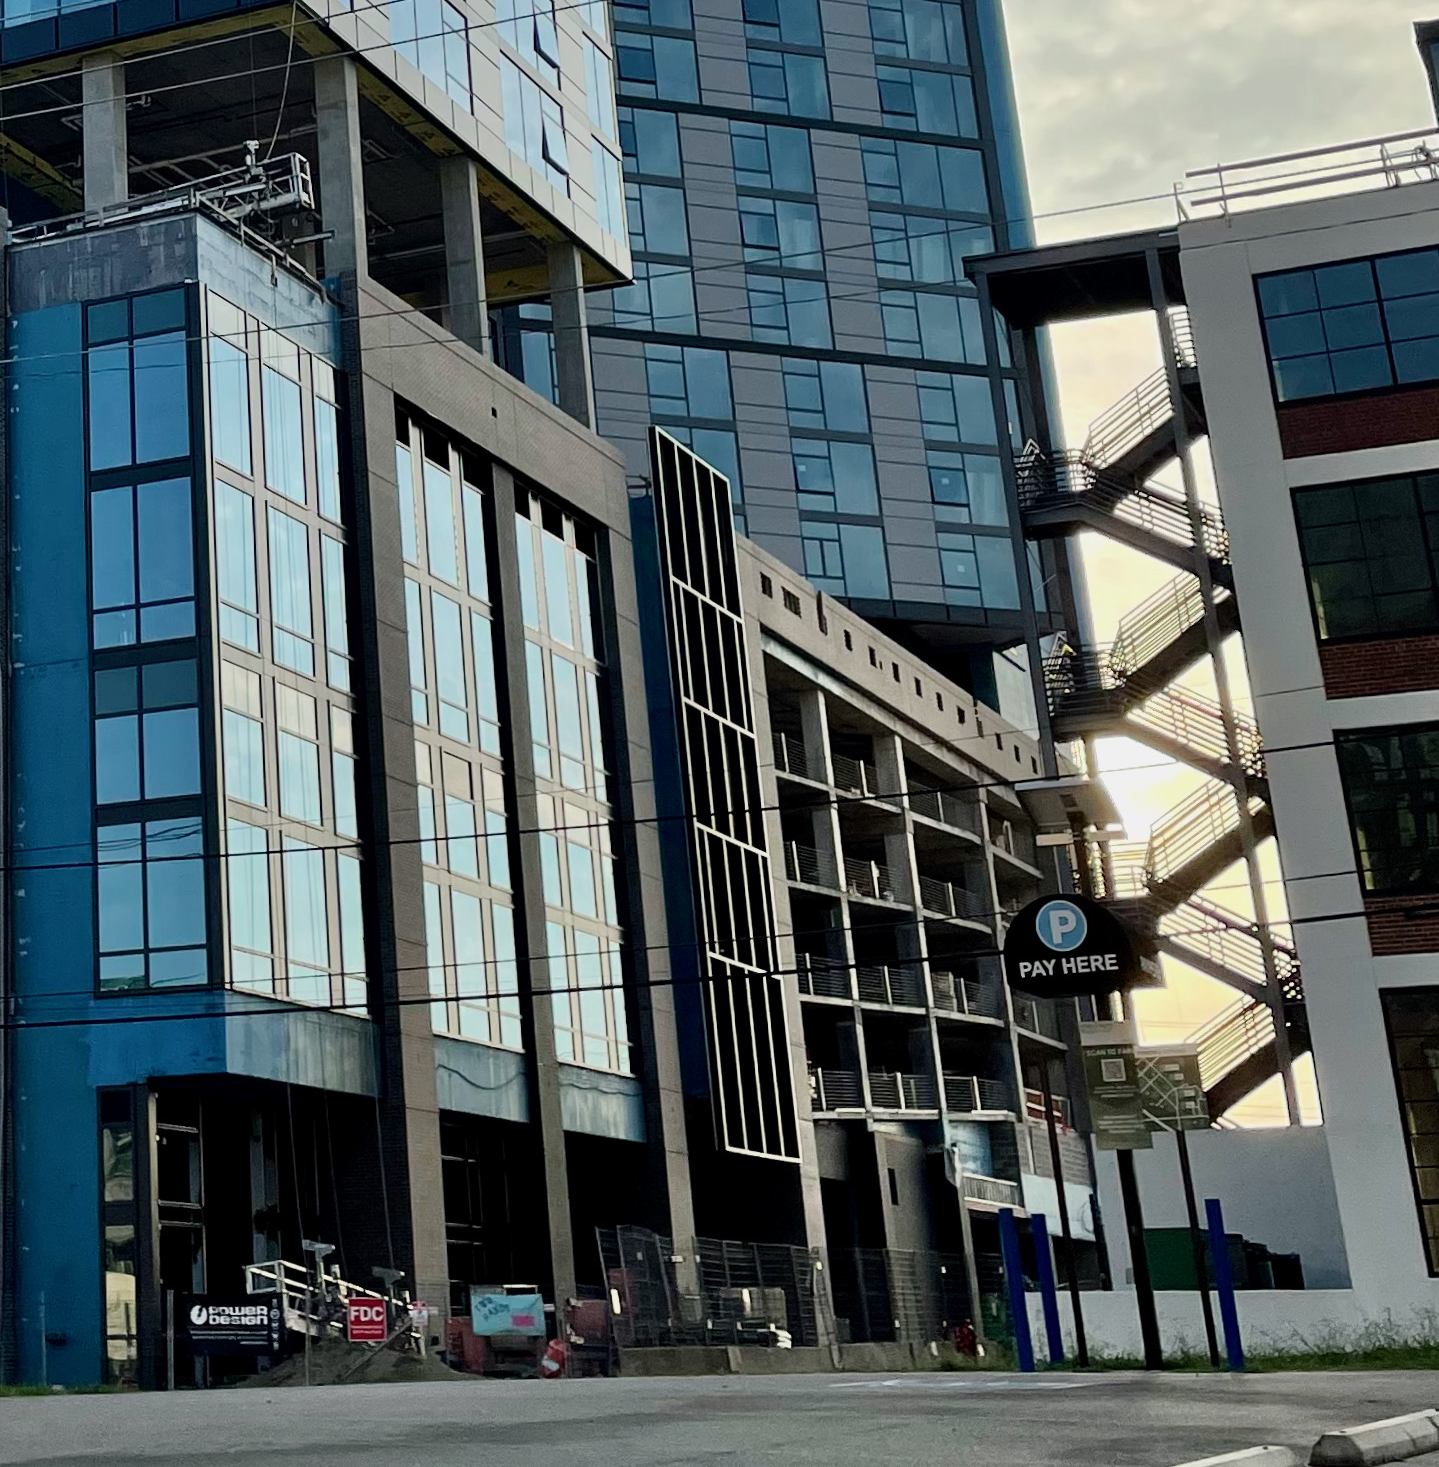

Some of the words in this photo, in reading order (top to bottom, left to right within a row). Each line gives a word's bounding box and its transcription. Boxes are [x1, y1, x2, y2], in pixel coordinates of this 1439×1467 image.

[1049, 909, 1077, 945] P
[1019, 958, 1057, 979] PAY
[1061, 954, 1119, 975] HERE
[350, 1306, 384, 1322] FDC
